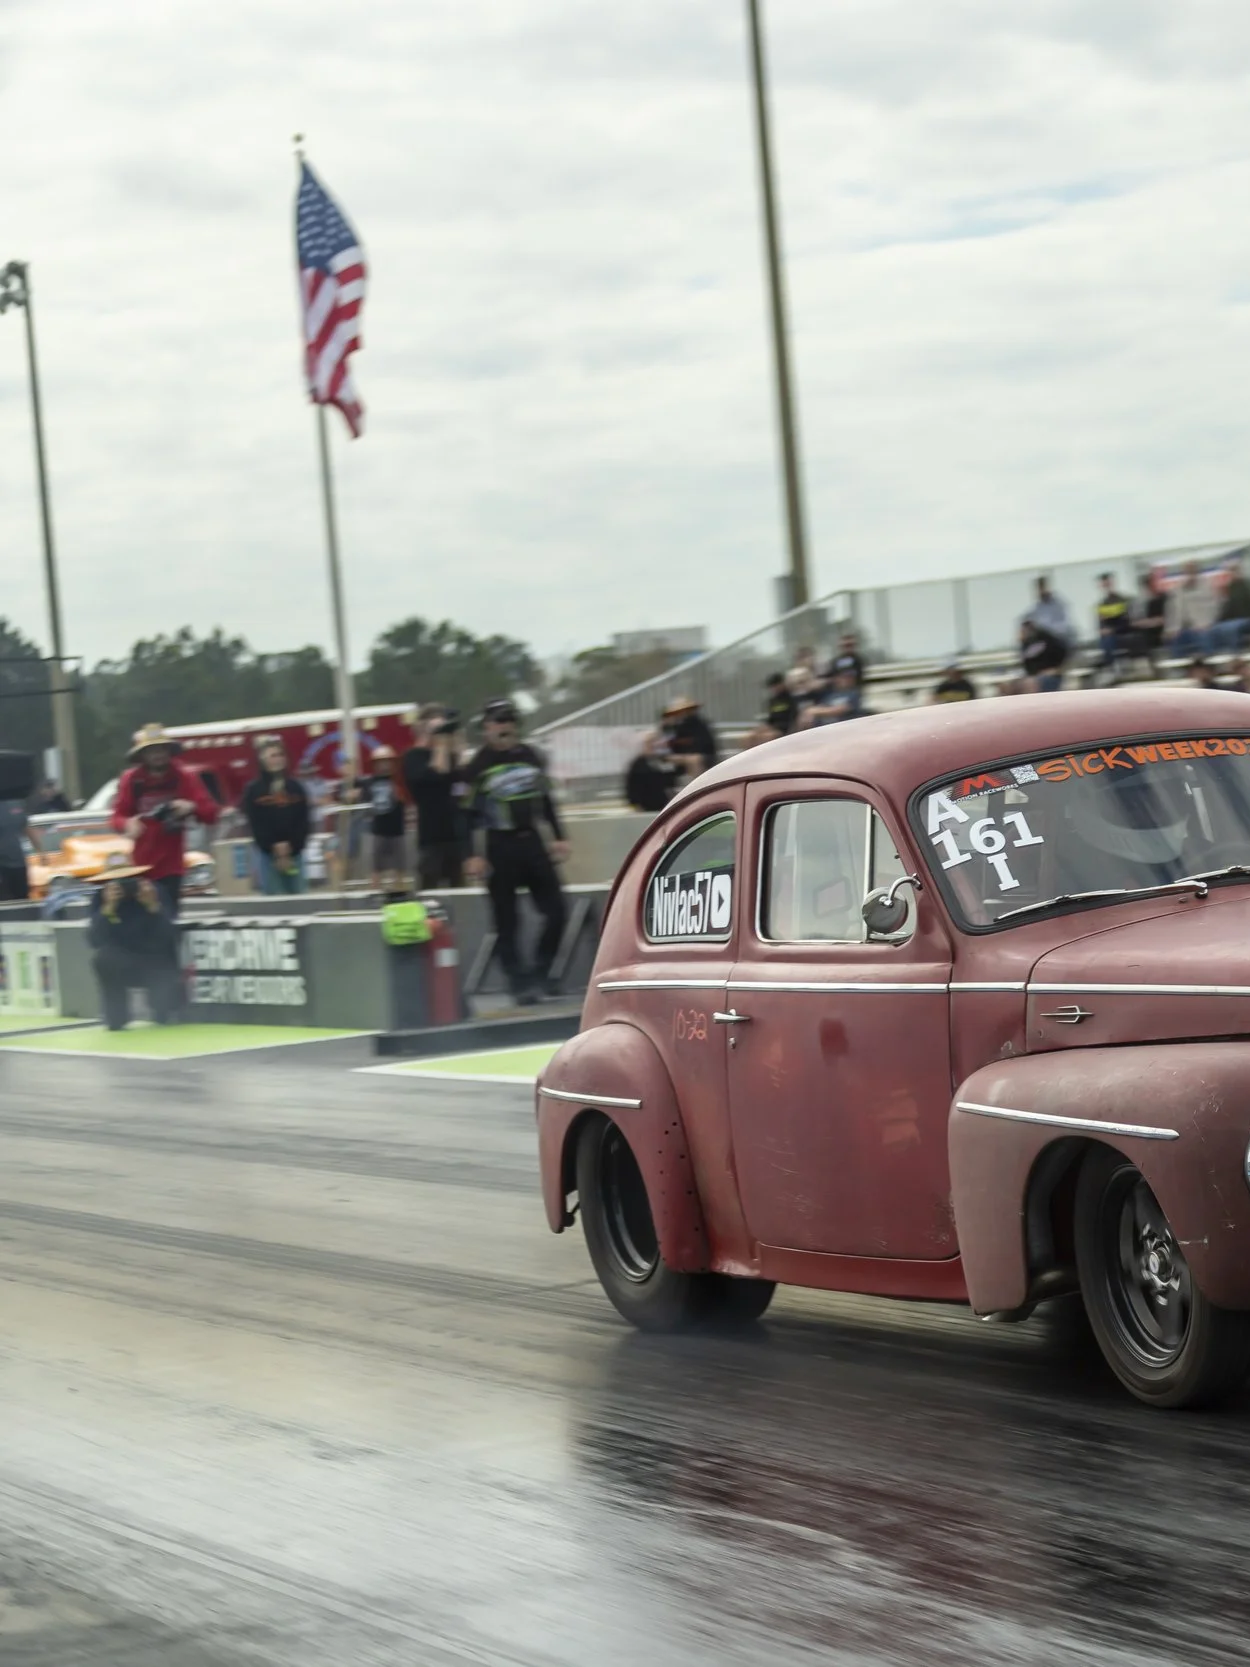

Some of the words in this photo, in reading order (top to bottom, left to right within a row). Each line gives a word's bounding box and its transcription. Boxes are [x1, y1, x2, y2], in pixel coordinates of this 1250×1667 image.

[928, 787, 970, 836] A
[931, 811, 1044, 870] 161
[652, 871, 713, 937] Nivlac57
